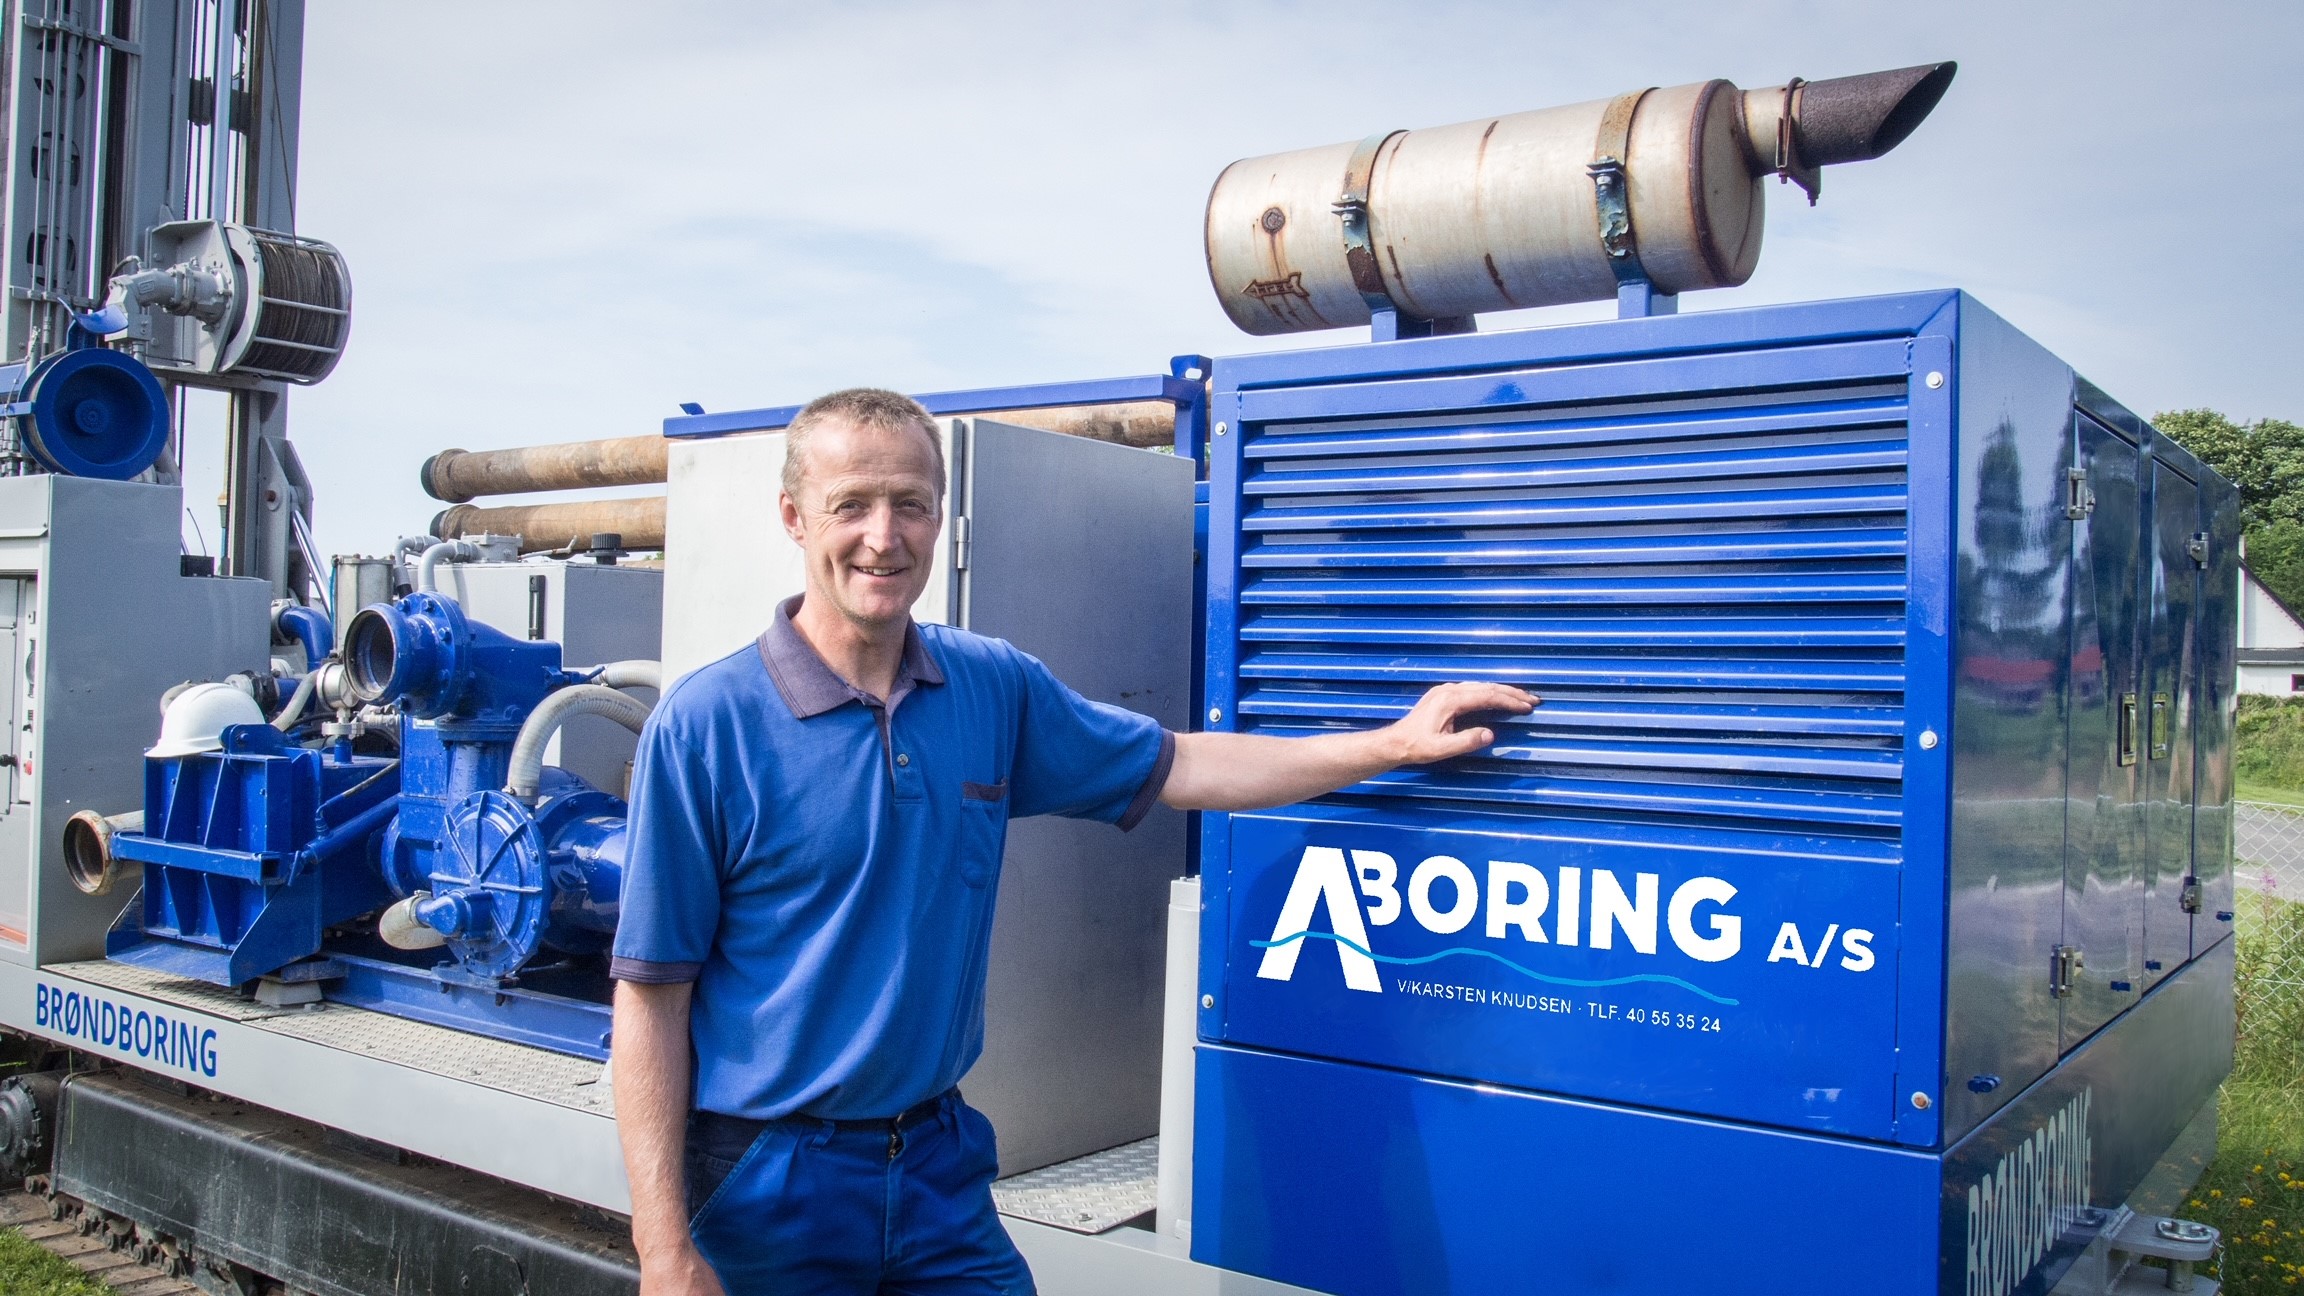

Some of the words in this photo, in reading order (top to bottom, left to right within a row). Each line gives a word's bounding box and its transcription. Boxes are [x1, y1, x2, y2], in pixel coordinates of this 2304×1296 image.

[1766, 922, 1875, 972] A/S
[36, 983, 217, 1078] BRØNDBORING
[1397, 979, 1486, 1003] V/KARSTEN
[1491, 990, 1571, 1014] KNUDSEN
[1587, 1002, 1621, 1021] TLF.
[1626, 1007, 1645, 1023] 40
[1651, 1010, 1670, 1026] 55
[1676, 1013, 1695, 1030] 35
[1701, 1016, 1721, 1033] 24
[1967, 1086, 2091, 1296] BRØNDBORING
